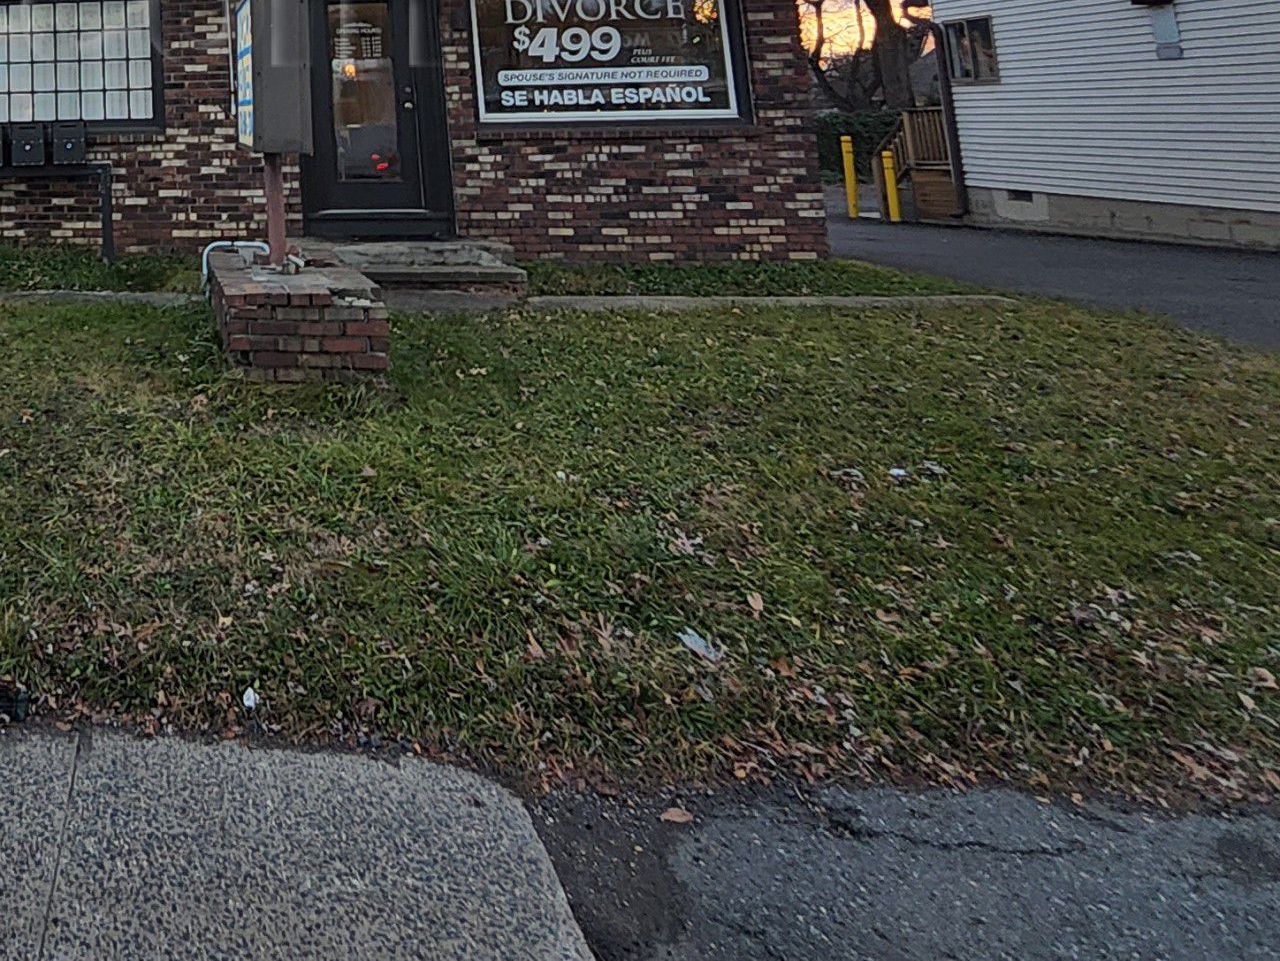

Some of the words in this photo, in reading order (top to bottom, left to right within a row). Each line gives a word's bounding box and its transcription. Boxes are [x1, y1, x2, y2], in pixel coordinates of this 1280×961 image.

[513, 24, 621, 63] $499
[503, 72, 555, 82] SPOUSE'S
[557, 70, 618, 81] SIGNATURE
[620, 69, 644, 80] NOT
[645, 68, 703, 79] REQUIRED
[500, 90, 528, 107] SE
[534, 88, 606, 106] HABLA
[610, 83, 712, 105] ESPAÑOL
